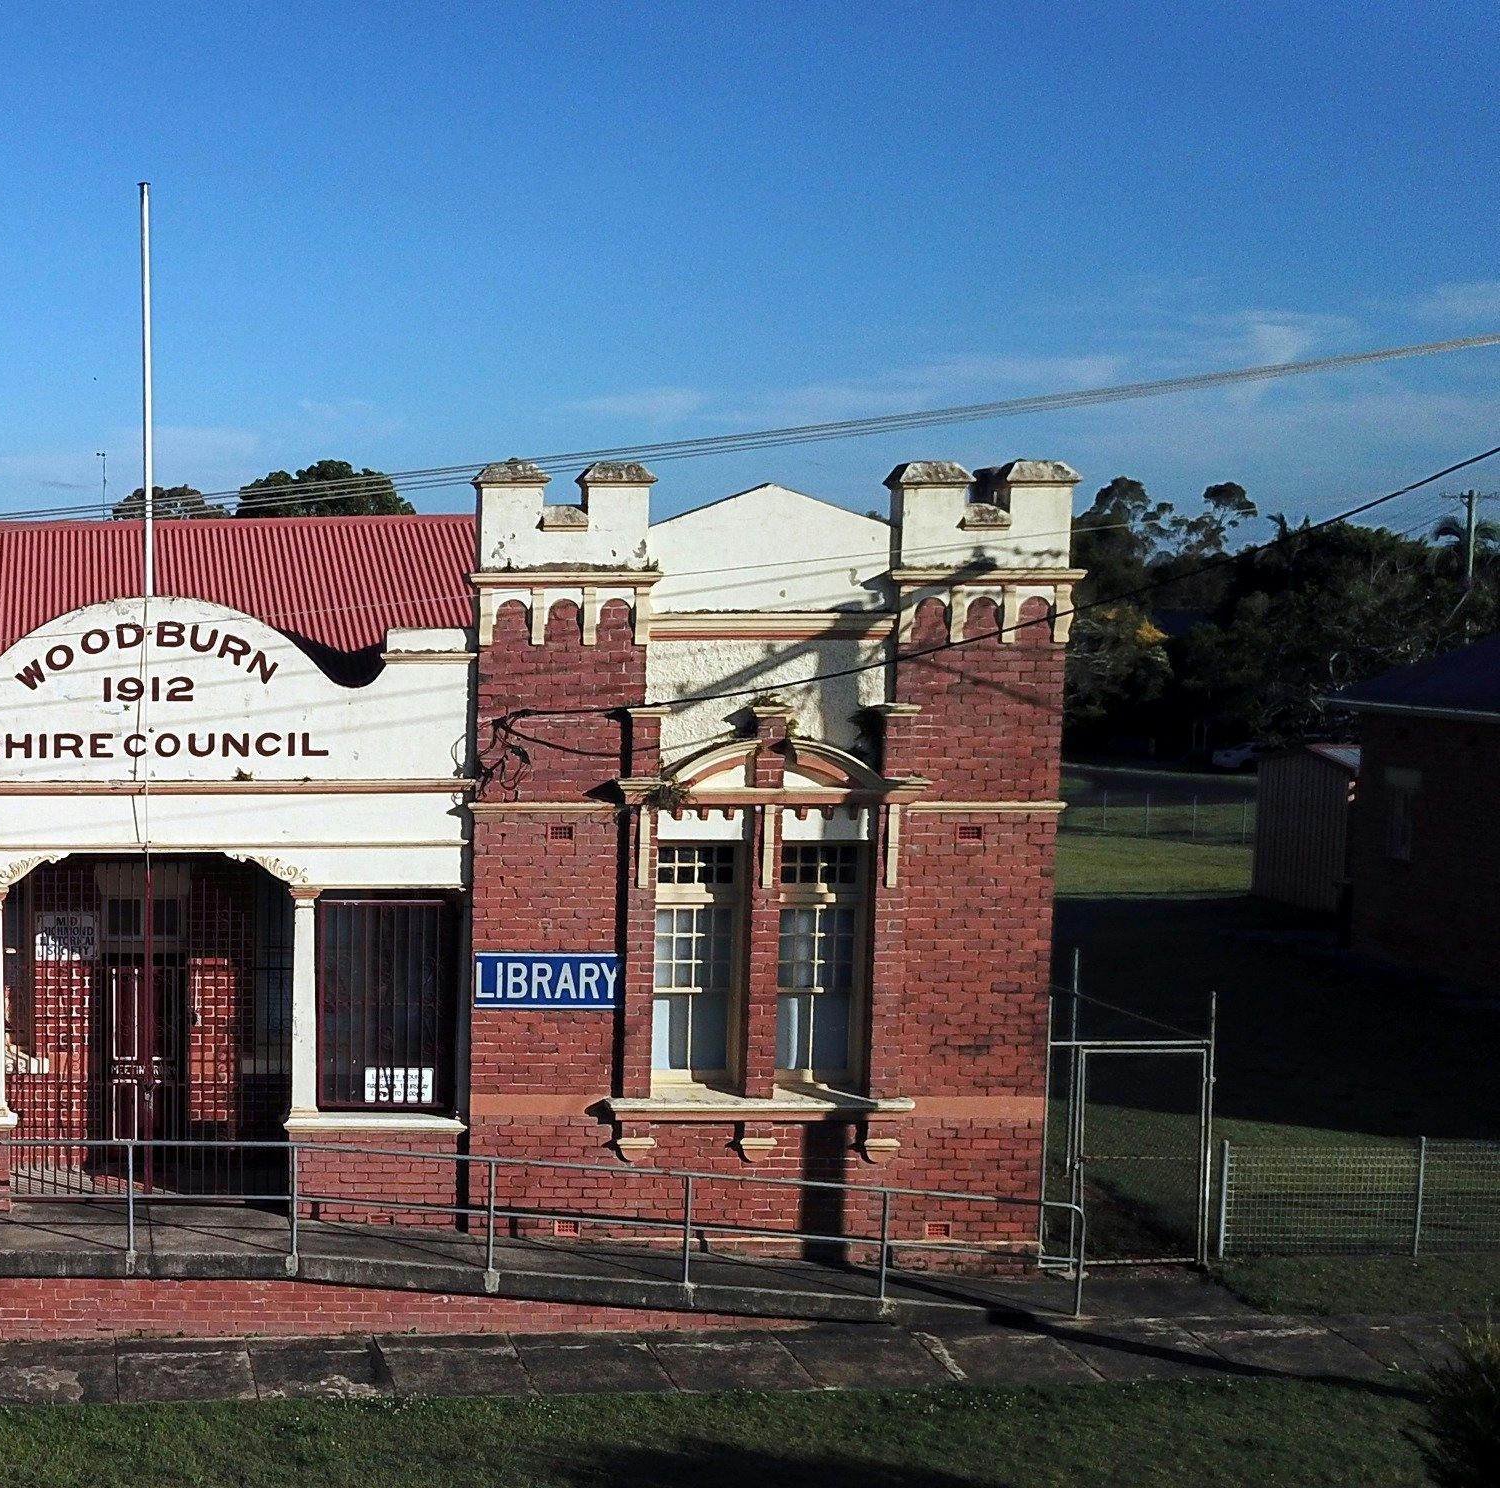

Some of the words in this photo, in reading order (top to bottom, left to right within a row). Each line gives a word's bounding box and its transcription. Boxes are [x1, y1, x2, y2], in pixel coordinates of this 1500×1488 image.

[14, 621, 279, 691] WOODBURN
[102, 676, 194, 703] 1912
[123, 732, 329, 758] COUNCIL
[47, 946, 90, 956] SOCETY
[475, 961, 620, 999] LIBRARY
[111, 1065, 149, 1075] MEETIN
